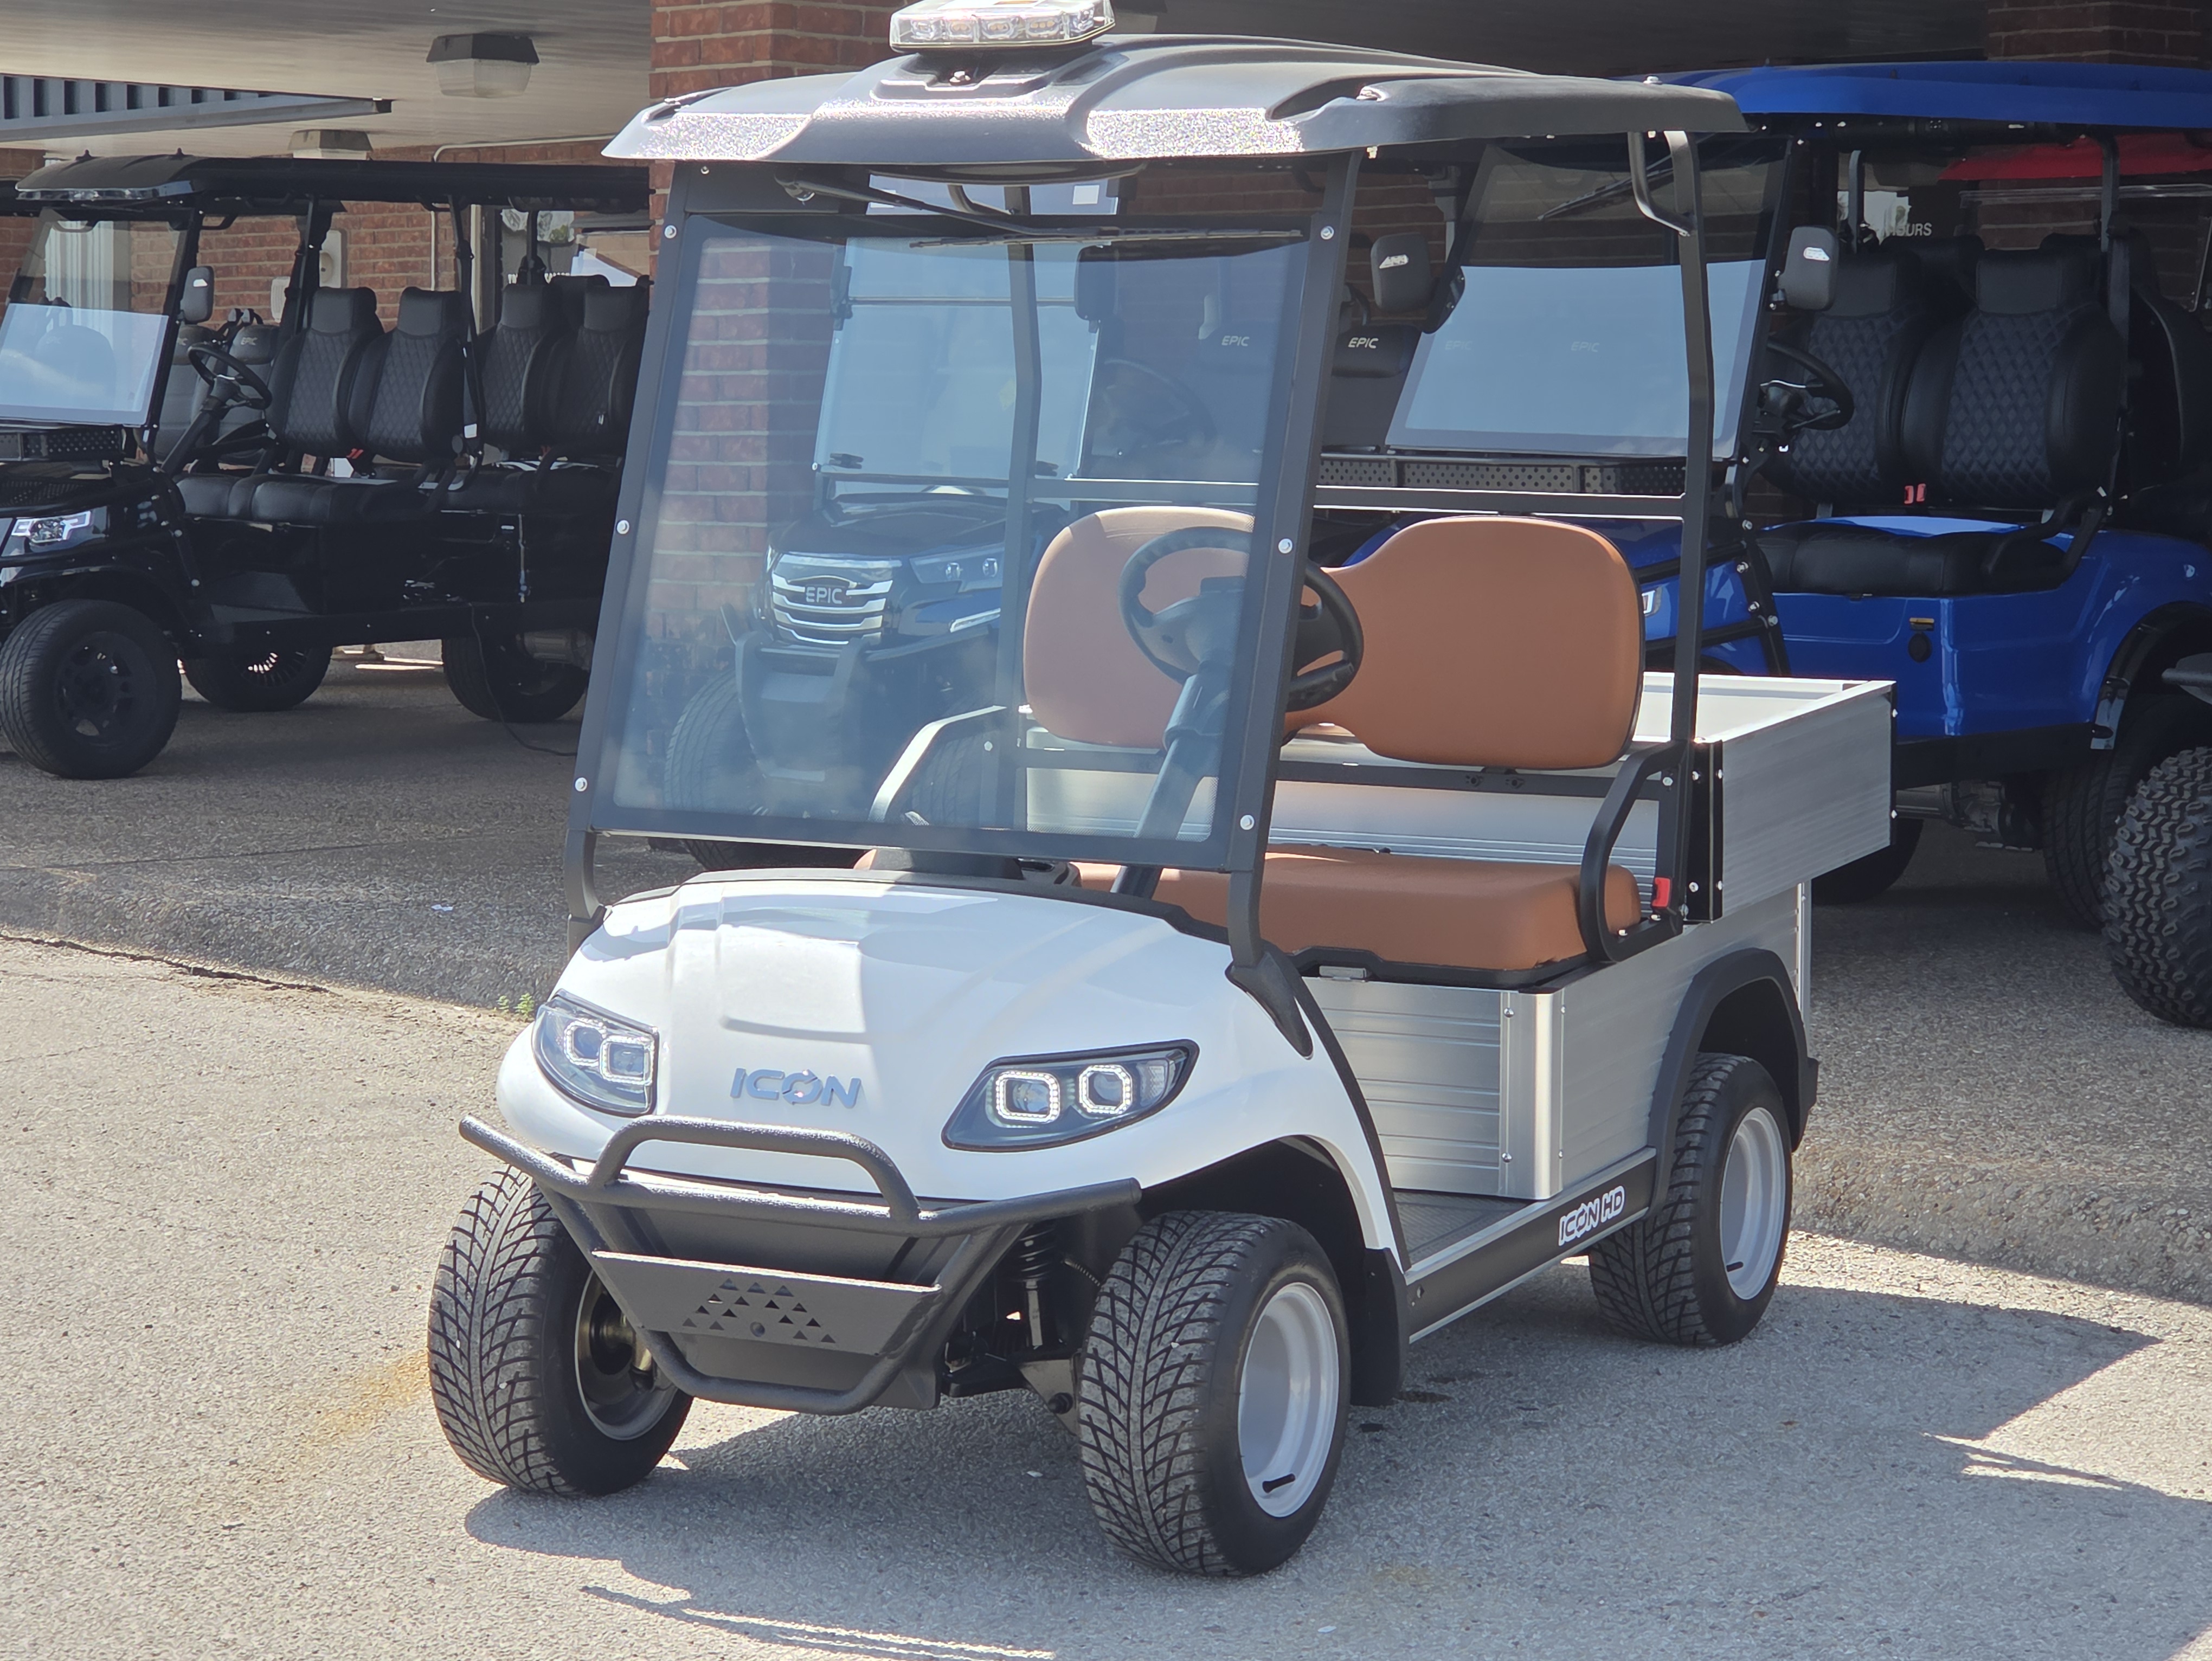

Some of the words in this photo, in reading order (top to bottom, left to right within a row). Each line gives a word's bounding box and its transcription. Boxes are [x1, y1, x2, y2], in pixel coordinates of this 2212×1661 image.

[1221, 335, 1250, 346] EPIC
[1348, 337, 1379, 349] EPIC
[1444, 340, 1473, 351] EPIC
[1571, 341, 1600, 352] EPIC
[806, 587, 843, 604] EPIC
[730, 1067, 862, 1109] ICON
[1558, 1198, 1600, 1246] ICON
[1601, 1185, 1625, 1223] HD
